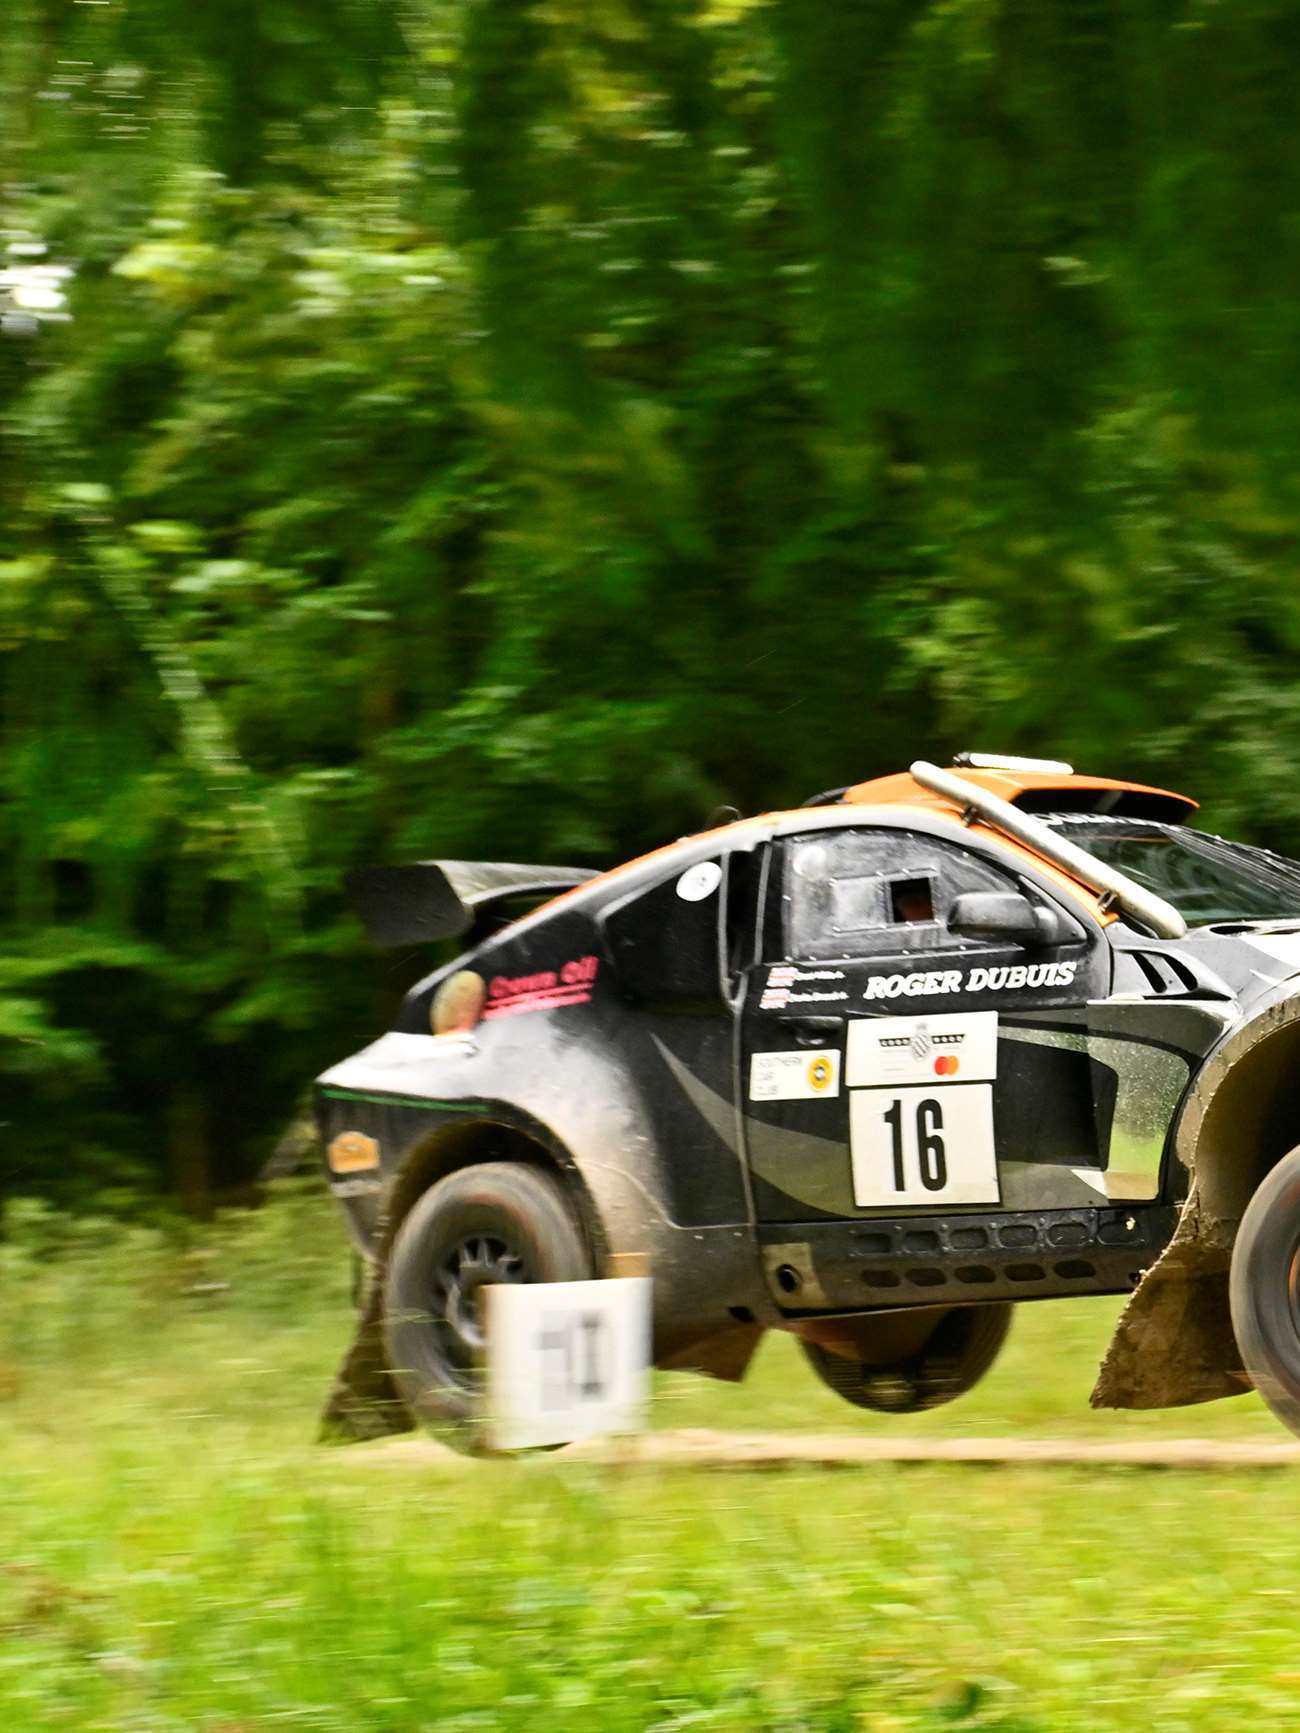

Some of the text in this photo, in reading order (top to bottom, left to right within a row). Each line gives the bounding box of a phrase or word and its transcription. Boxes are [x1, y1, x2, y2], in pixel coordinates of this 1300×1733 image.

[863, 961, 1077, 1000] ROGER DUBUIS
[883, 1098, 948, 1192] 16
